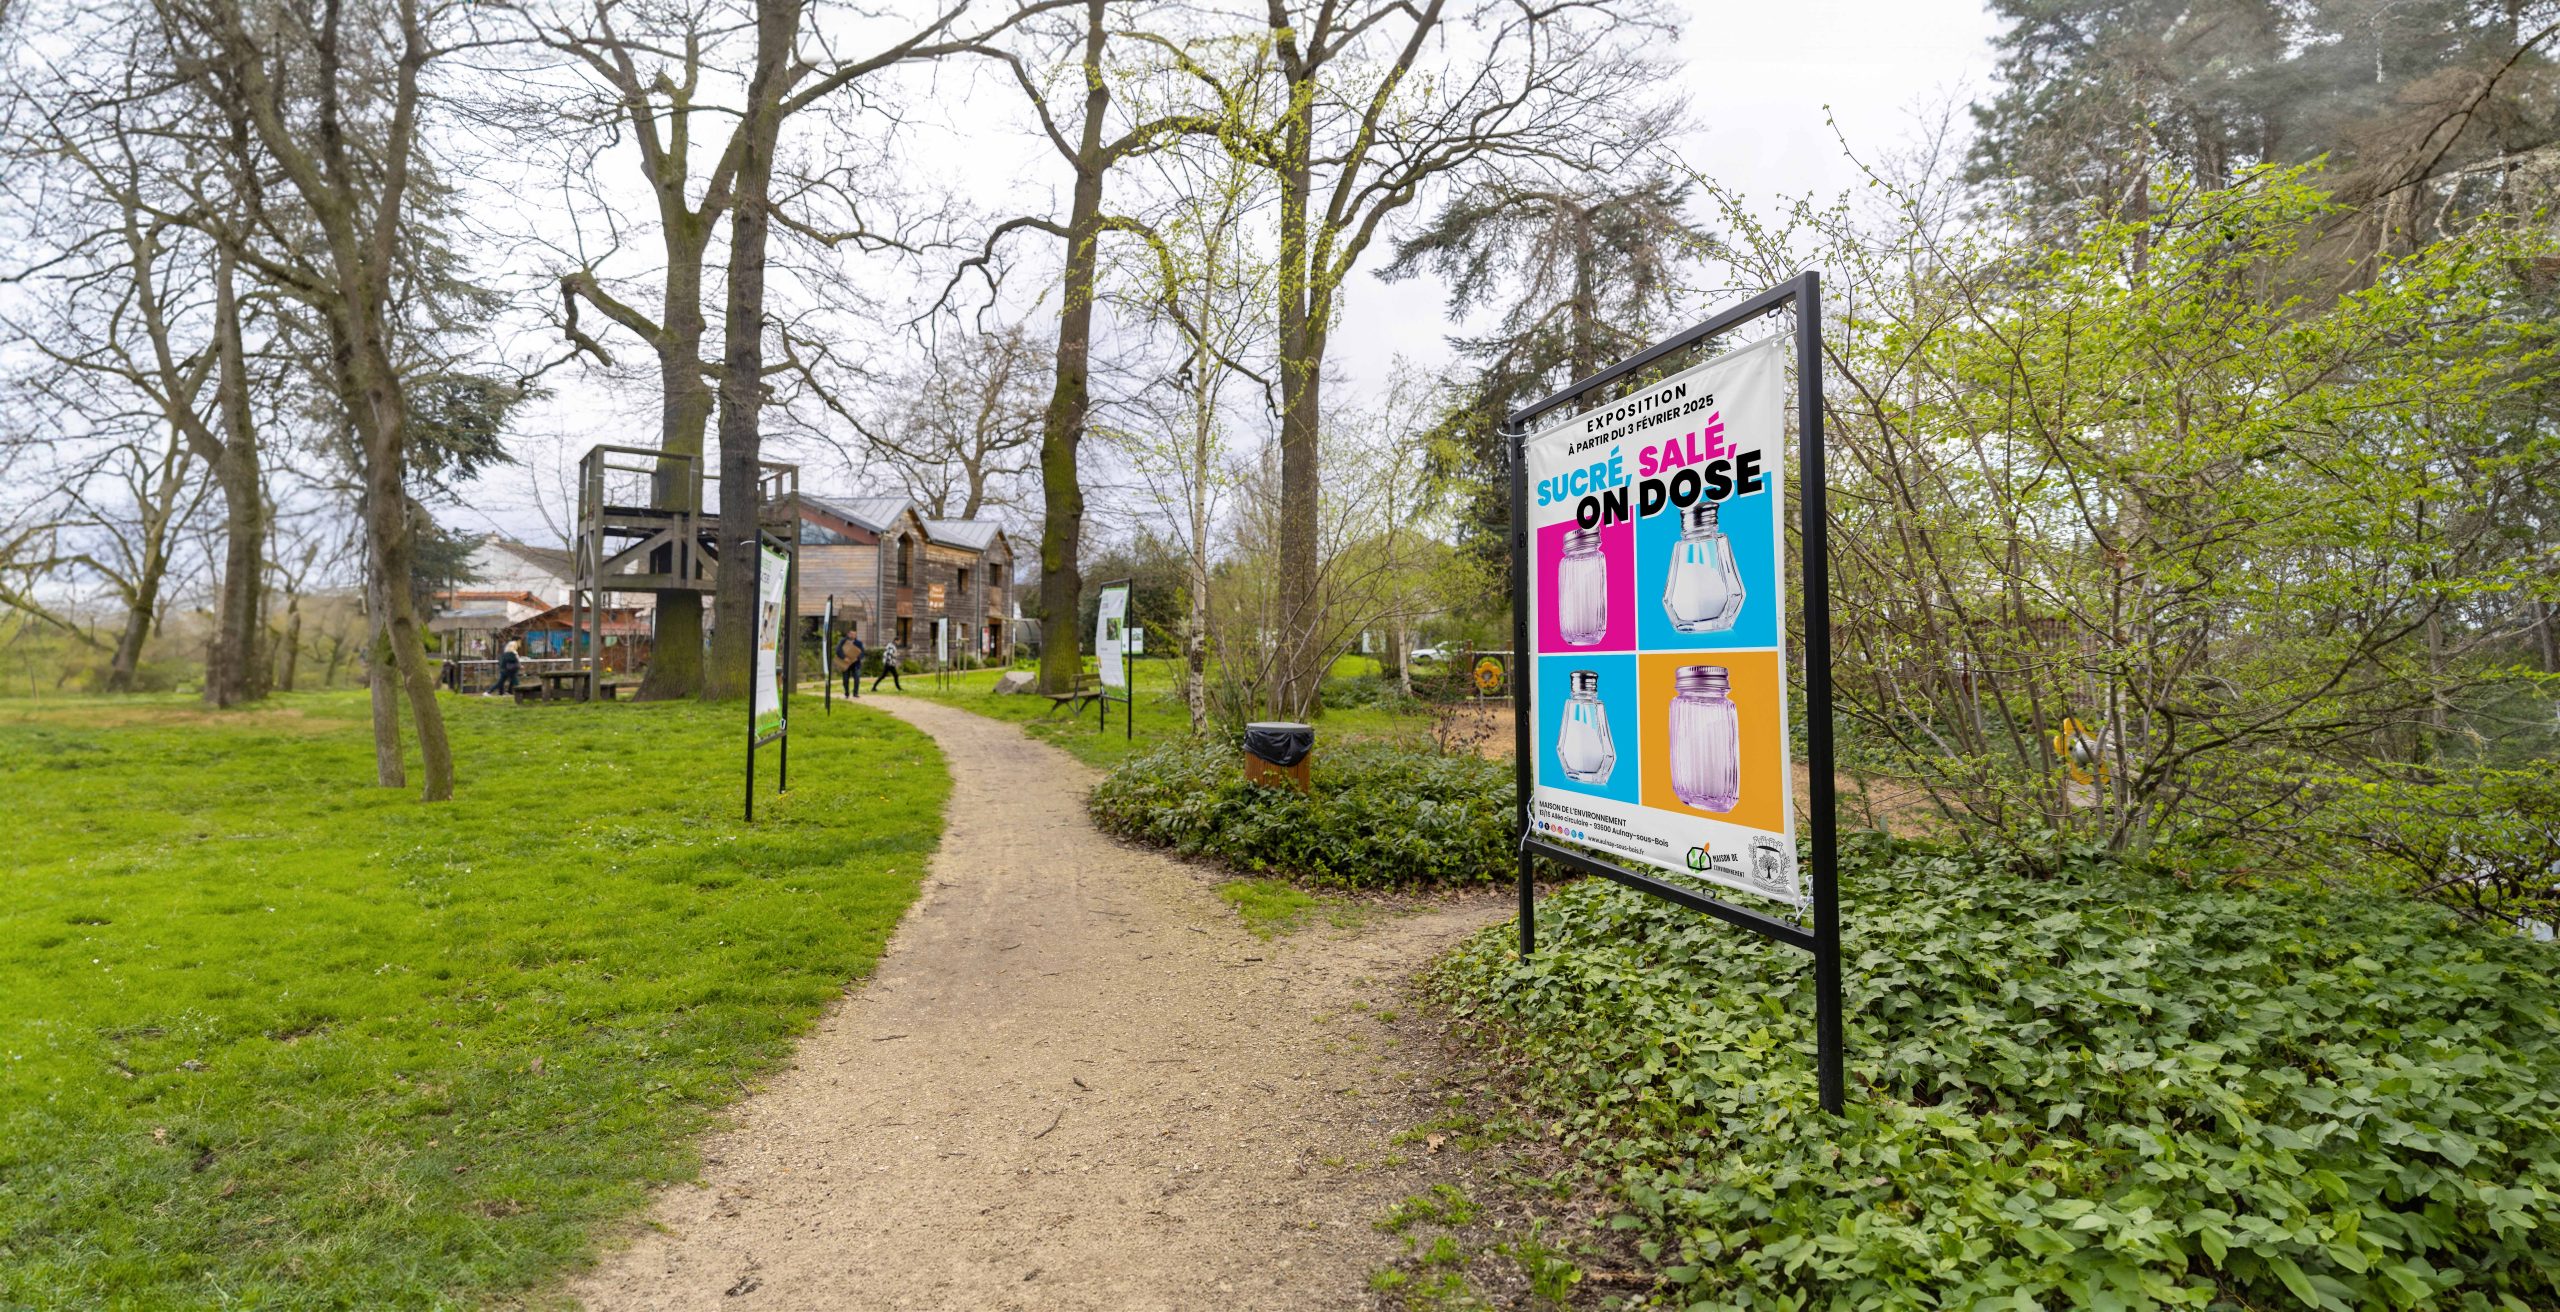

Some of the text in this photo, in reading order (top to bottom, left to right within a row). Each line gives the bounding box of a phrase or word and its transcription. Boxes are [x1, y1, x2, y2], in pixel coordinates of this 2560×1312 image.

[1568, 394, 1714, 456] À PARTIR DU 3 FÉVRIER 2025
[1587, 383, 1687, 433] EXPOSITION
[1537, 411, 1737, 507] SUCRÉ, SALÉ,
[1576, 449, 1762, 530] ON DOSE
[1539, 800, 1626, 827] MAISON DE L'ENVIRONNEMENT
[1564, 814, 1589, 828] circulaire
[1612, 827, 1669, 848] Aulnay-sous-Bois
[1712, 853, 1738, 863] MAISON DE
